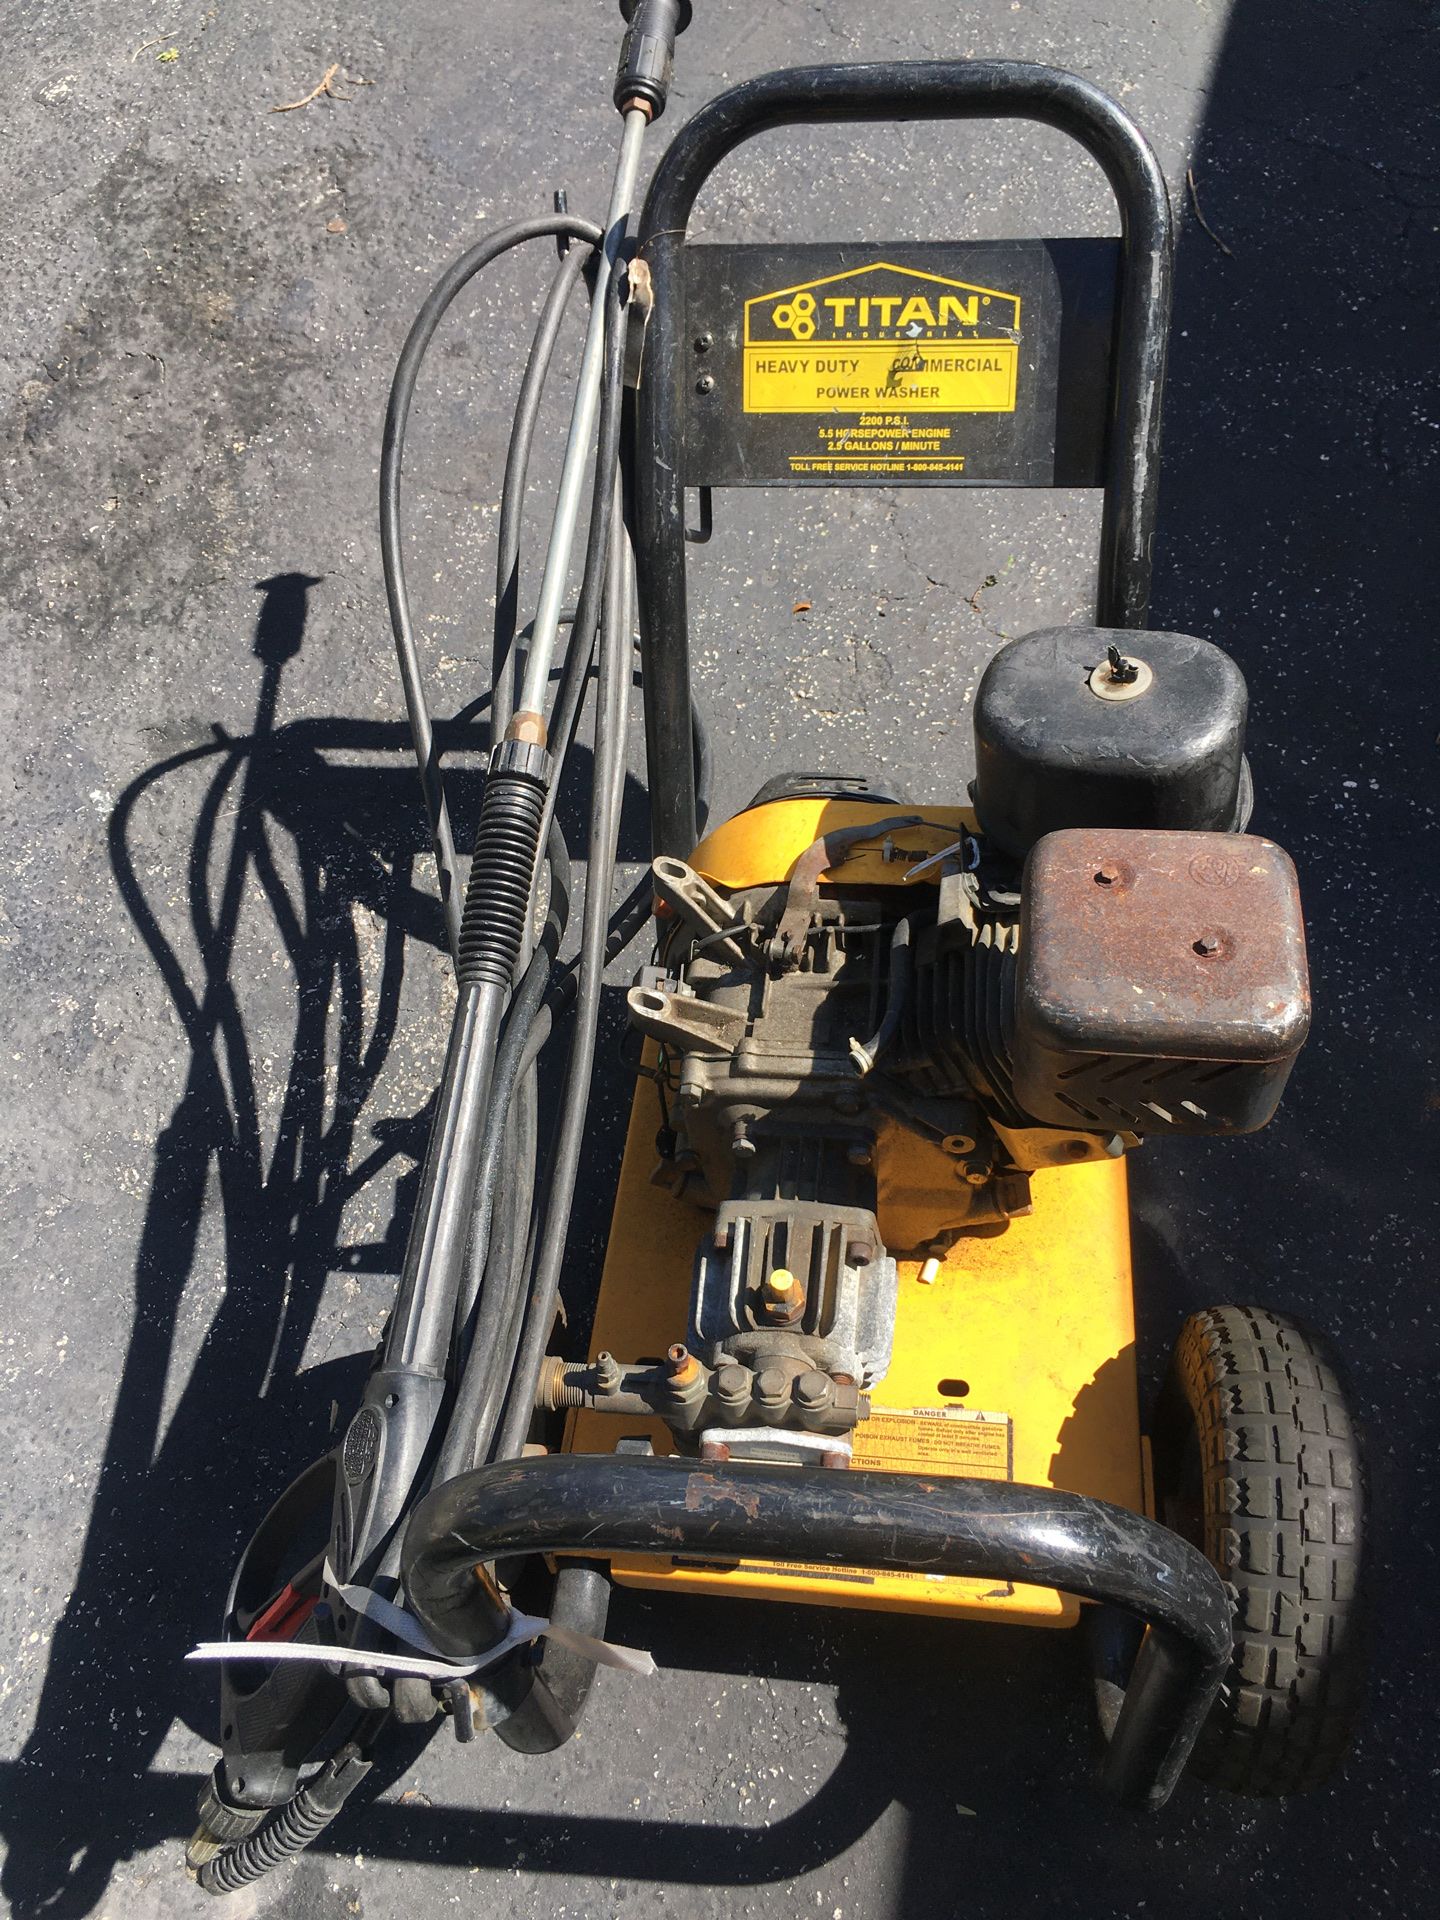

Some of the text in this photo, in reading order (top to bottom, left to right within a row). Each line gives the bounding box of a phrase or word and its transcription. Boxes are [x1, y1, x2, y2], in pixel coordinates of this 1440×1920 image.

[824, 296, 978, 327] TITAN
[832, 331, 978, 339] INDUSRIAL
[755, 360, 860, 373] HEAVY DUTY
[816, 387, 940, 399] POWER WASHER
[859, 416, 909, 426] 2200 P.S.I.
[819, 428, 951, 438] 5.5 HORSEPOWER ENGINE
[827, 441, 941, 451] 2.5 GALLONS / MINUTE
[789, 463, 811, 471] TOLL
[812, 463, 833, 471] FREE
[834, 463, 868, 471] SERVICE
[870, 463, 905, 471] HOTLINE
[913, 1409, 947, 1418] DANGER
[804, 1564, 830, 1572] Service
[832, 1566, 858, 1574] Hotline
